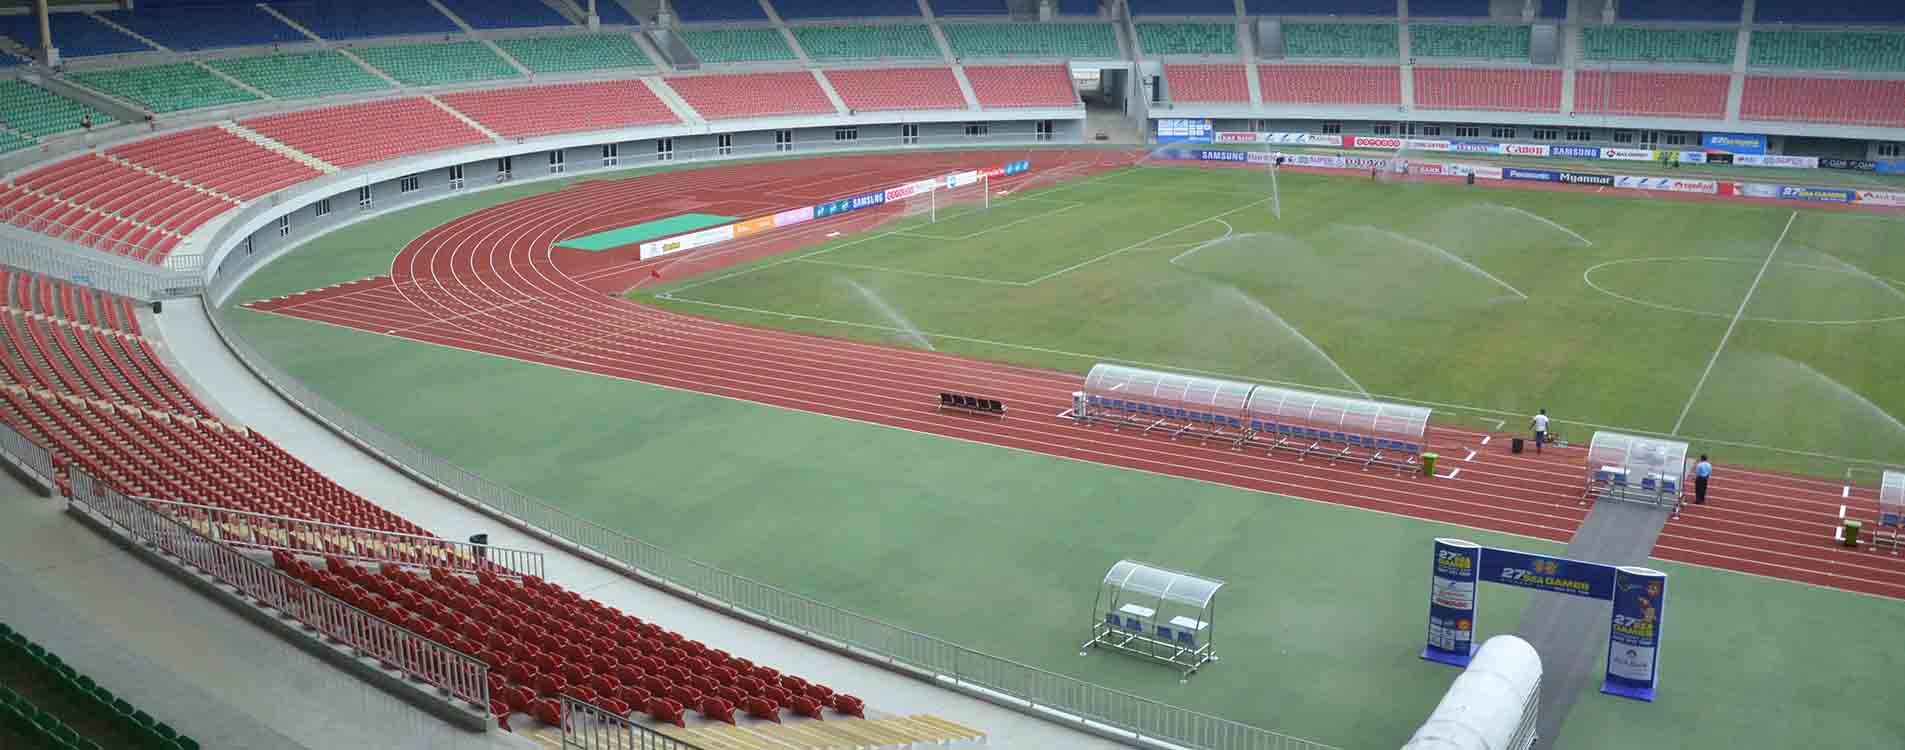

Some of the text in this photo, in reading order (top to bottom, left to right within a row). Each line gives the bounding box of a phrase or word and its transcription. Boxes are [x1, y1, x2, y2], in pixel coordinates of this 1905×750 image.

[1201, 151, 1244, 160] SAMSUNG
[1506, 146, 1543, 156] Canon
[1552, 147, 1597, 157] SAMSUNG
[1560, 173, 1609, 184] Myanmar
[852, 192, 884, 208] SAMSUNG
